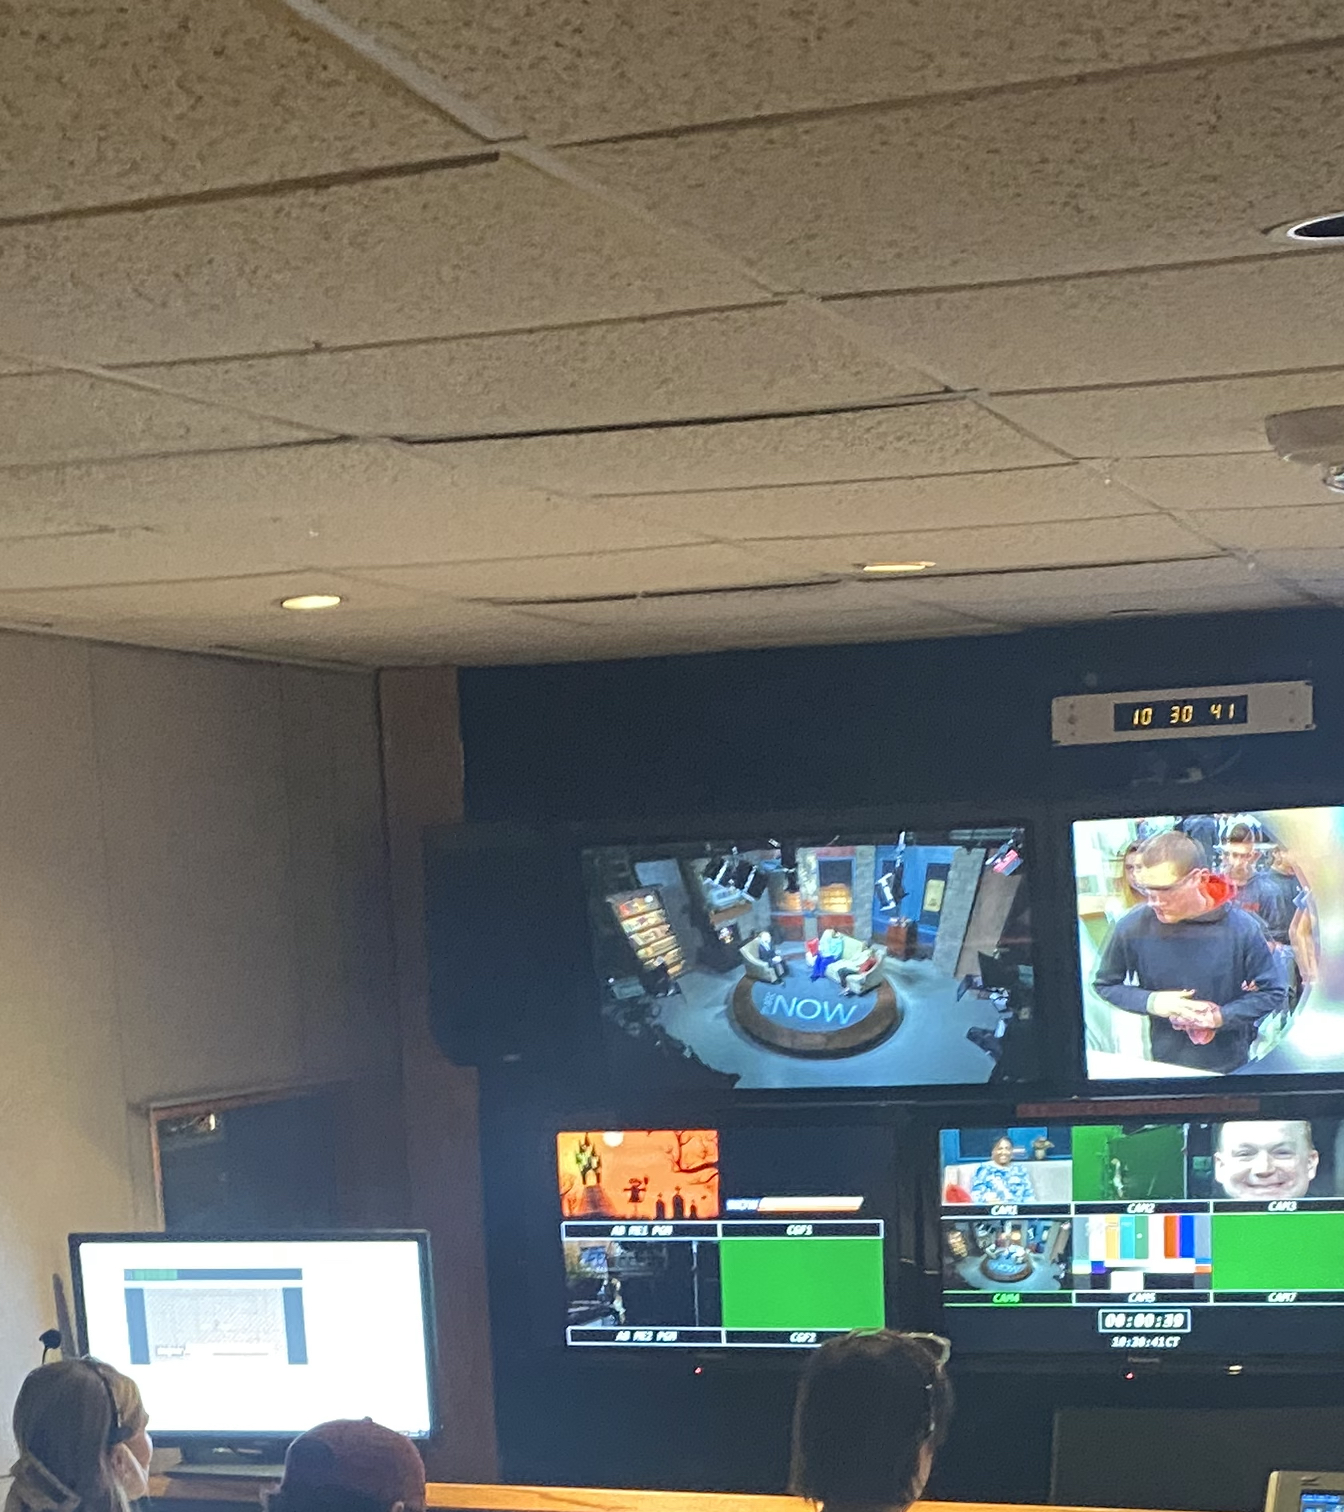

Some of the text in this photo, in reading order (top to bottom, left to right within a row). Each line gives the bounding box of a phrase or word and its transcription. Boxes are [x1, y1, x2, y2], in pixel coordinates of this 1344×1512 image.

[1132, 703, 1234, 726] 10 30 41
[771, 995, 857, 1025] NOW
